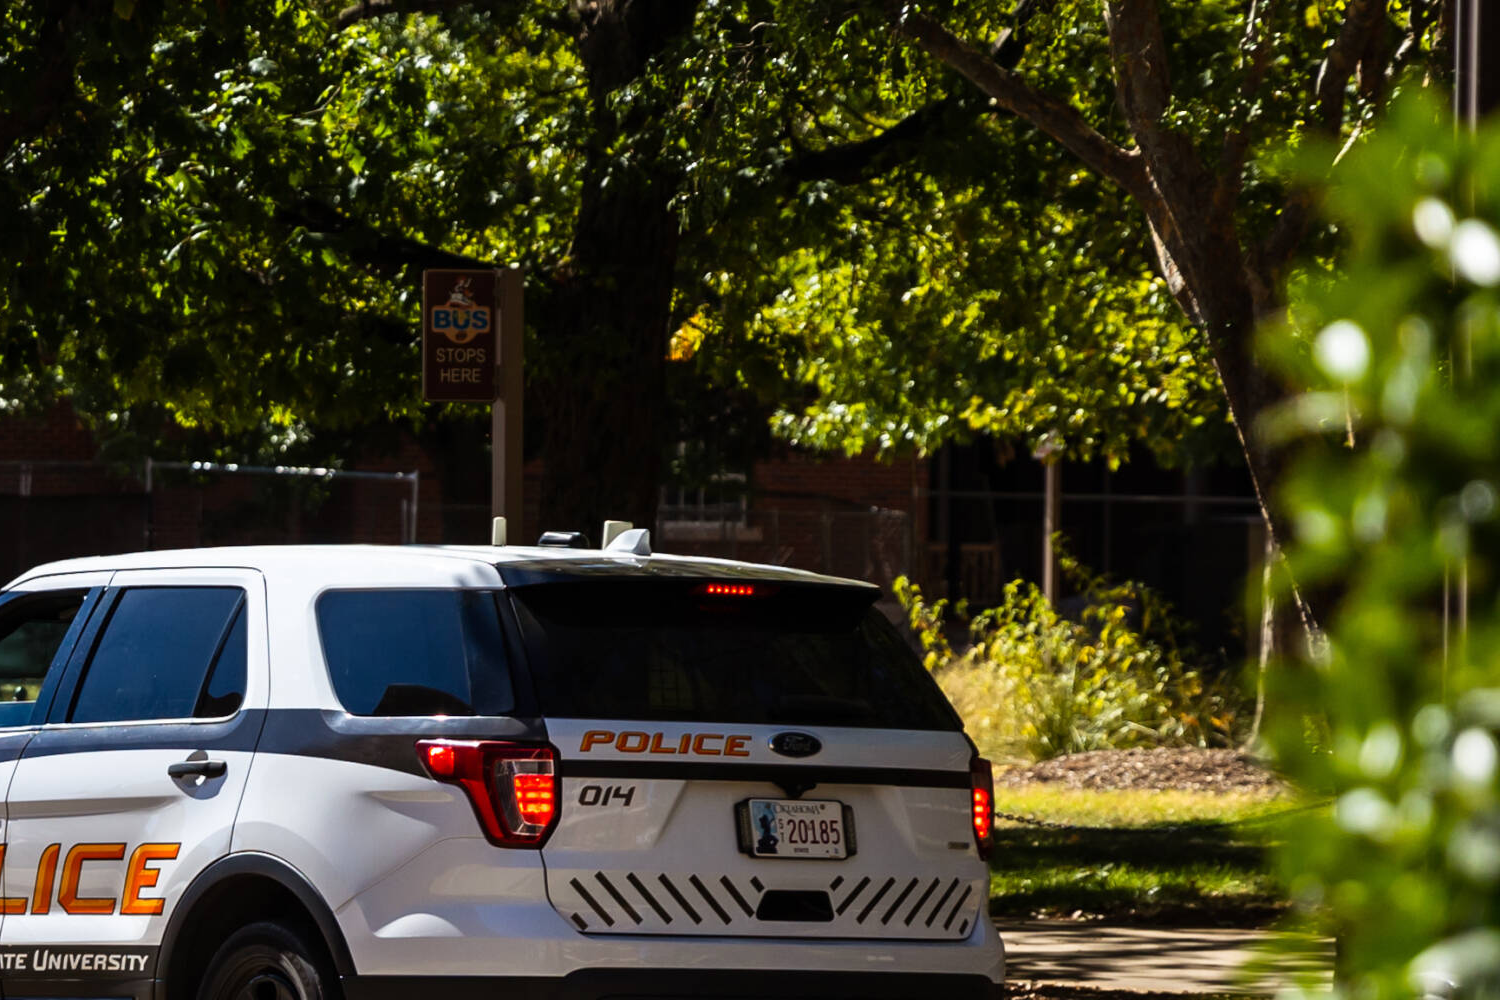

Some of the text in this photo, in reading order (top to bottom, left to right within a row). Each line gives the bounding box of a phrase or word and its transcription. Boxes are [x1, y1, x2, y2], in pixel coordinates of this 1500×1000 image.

[434, 310, 488, 329] BUS
[436, 348, 486, 362] STOPS
[440, 368, 481, 382] HERE
[579, 730, 752, 756] POLICE
[578, 785, 636, 807] 014
[787, 818, 840, 845] 20185
[33, 950, 149, 972] UNIVERSITY
